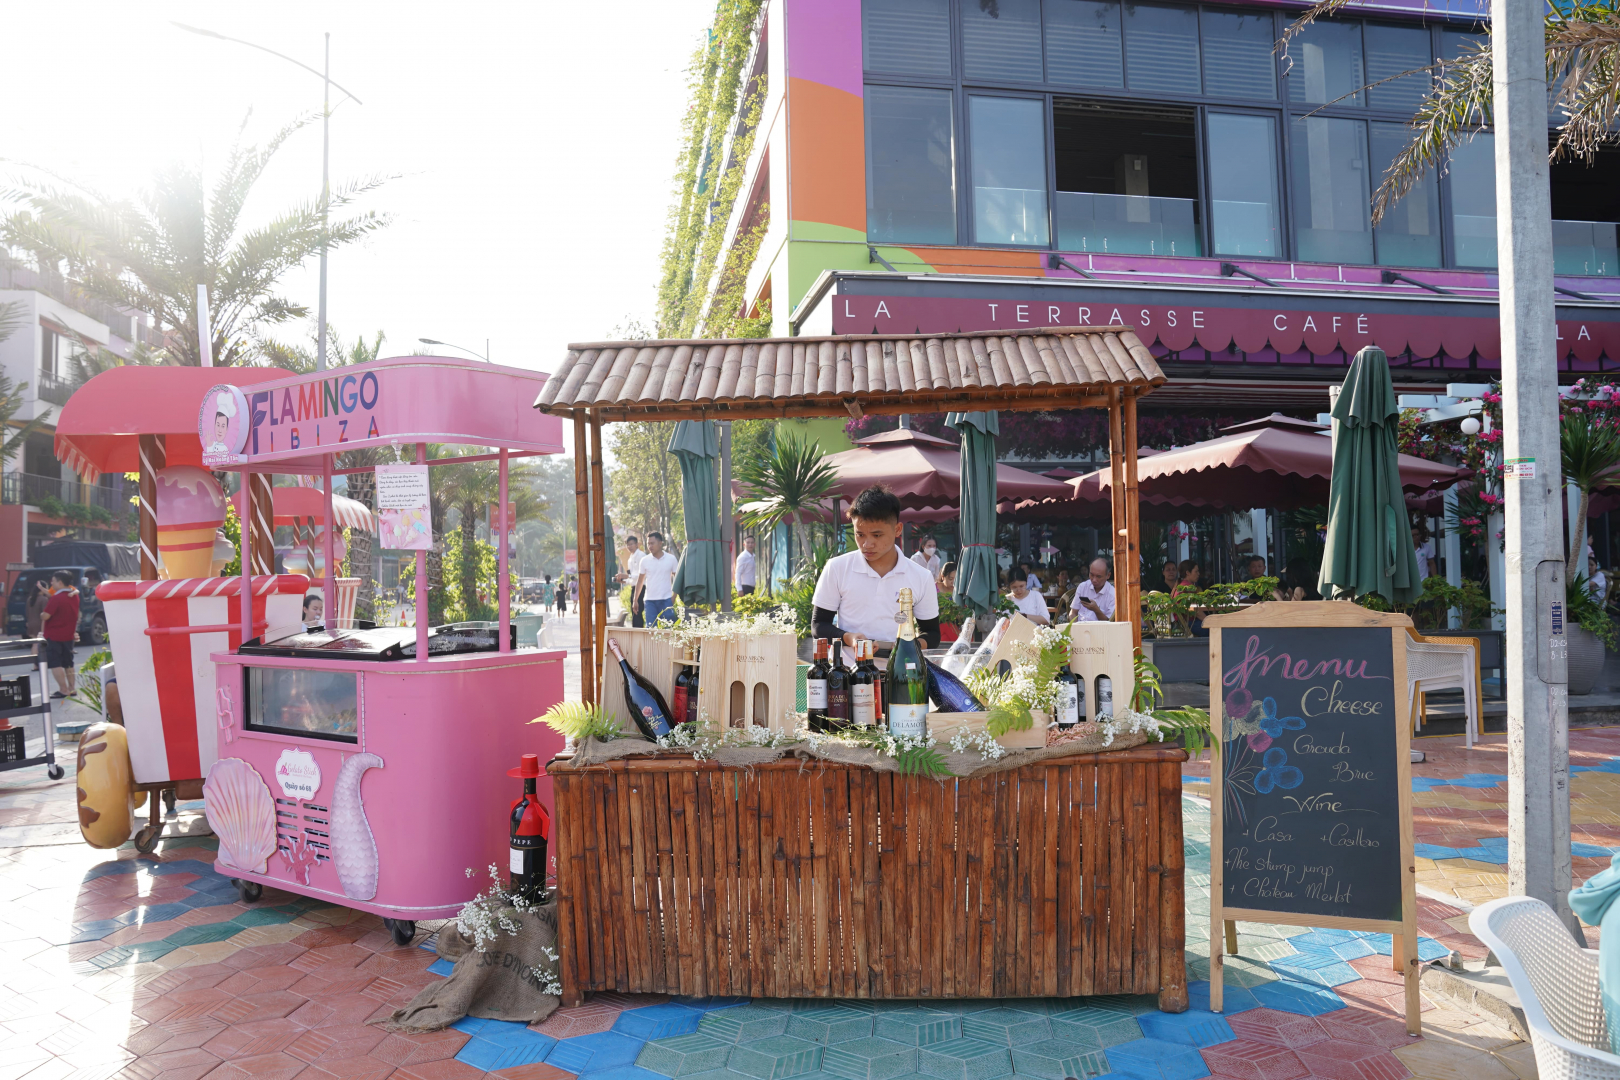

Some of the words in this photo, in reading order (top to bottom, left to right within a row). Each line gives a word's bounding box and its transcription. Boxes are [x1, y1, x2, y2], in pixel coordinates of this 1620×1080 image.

[845, 300, 891, 319] LA
[988, 303, 1205, 328] TERRASSE
[1273, 313, 1369, 334] CAFÉ
[1555, 324, 1591, 341] LA
[252, 371, 379, 455] FLAMINGO
[270, 415, 380, 452] IBIZA
[1301, 680, 1383, 718] Cheese
[1282, 793, 1343, 813] Wine
[1254, 815, 1296, 843] Casa
